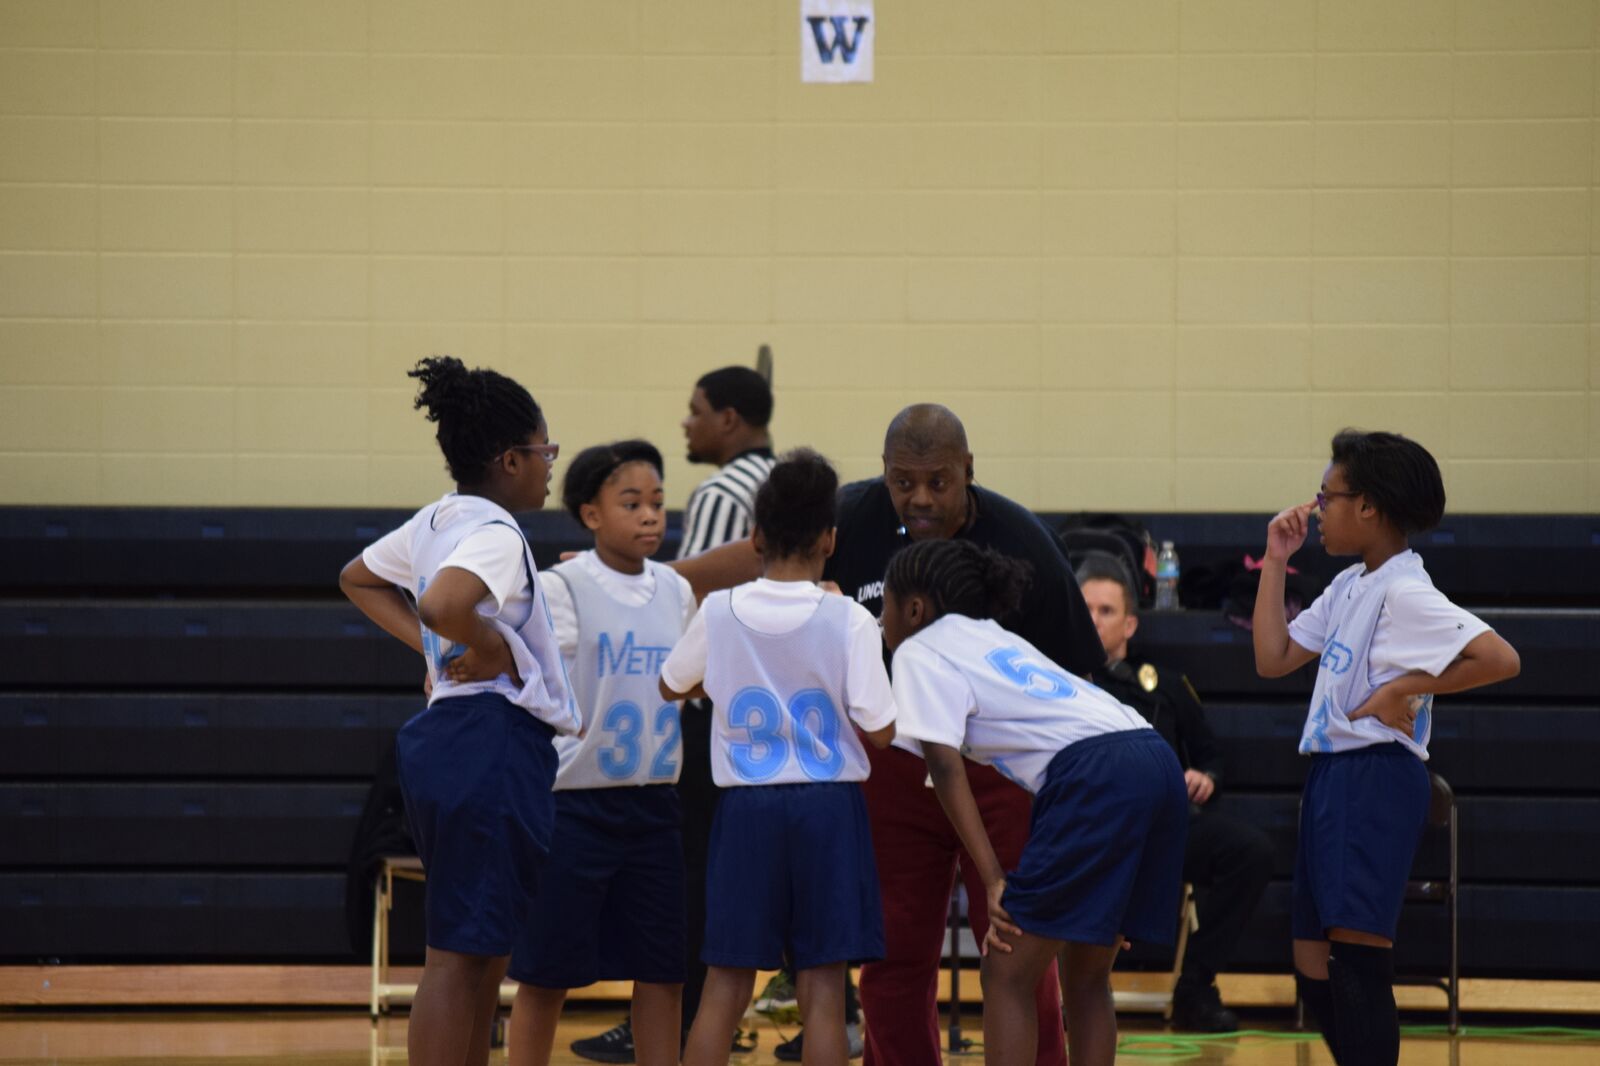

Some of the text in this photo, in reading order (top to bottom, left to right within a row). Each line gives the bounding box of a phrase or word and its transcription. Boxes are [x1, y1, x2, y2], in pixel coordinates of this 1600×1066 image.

[806, 16, 870, 64] W
[985, 647, 1077, 700] 5
[597, 700, 682, 781] 32
[728, 687, 845, 783] 30
